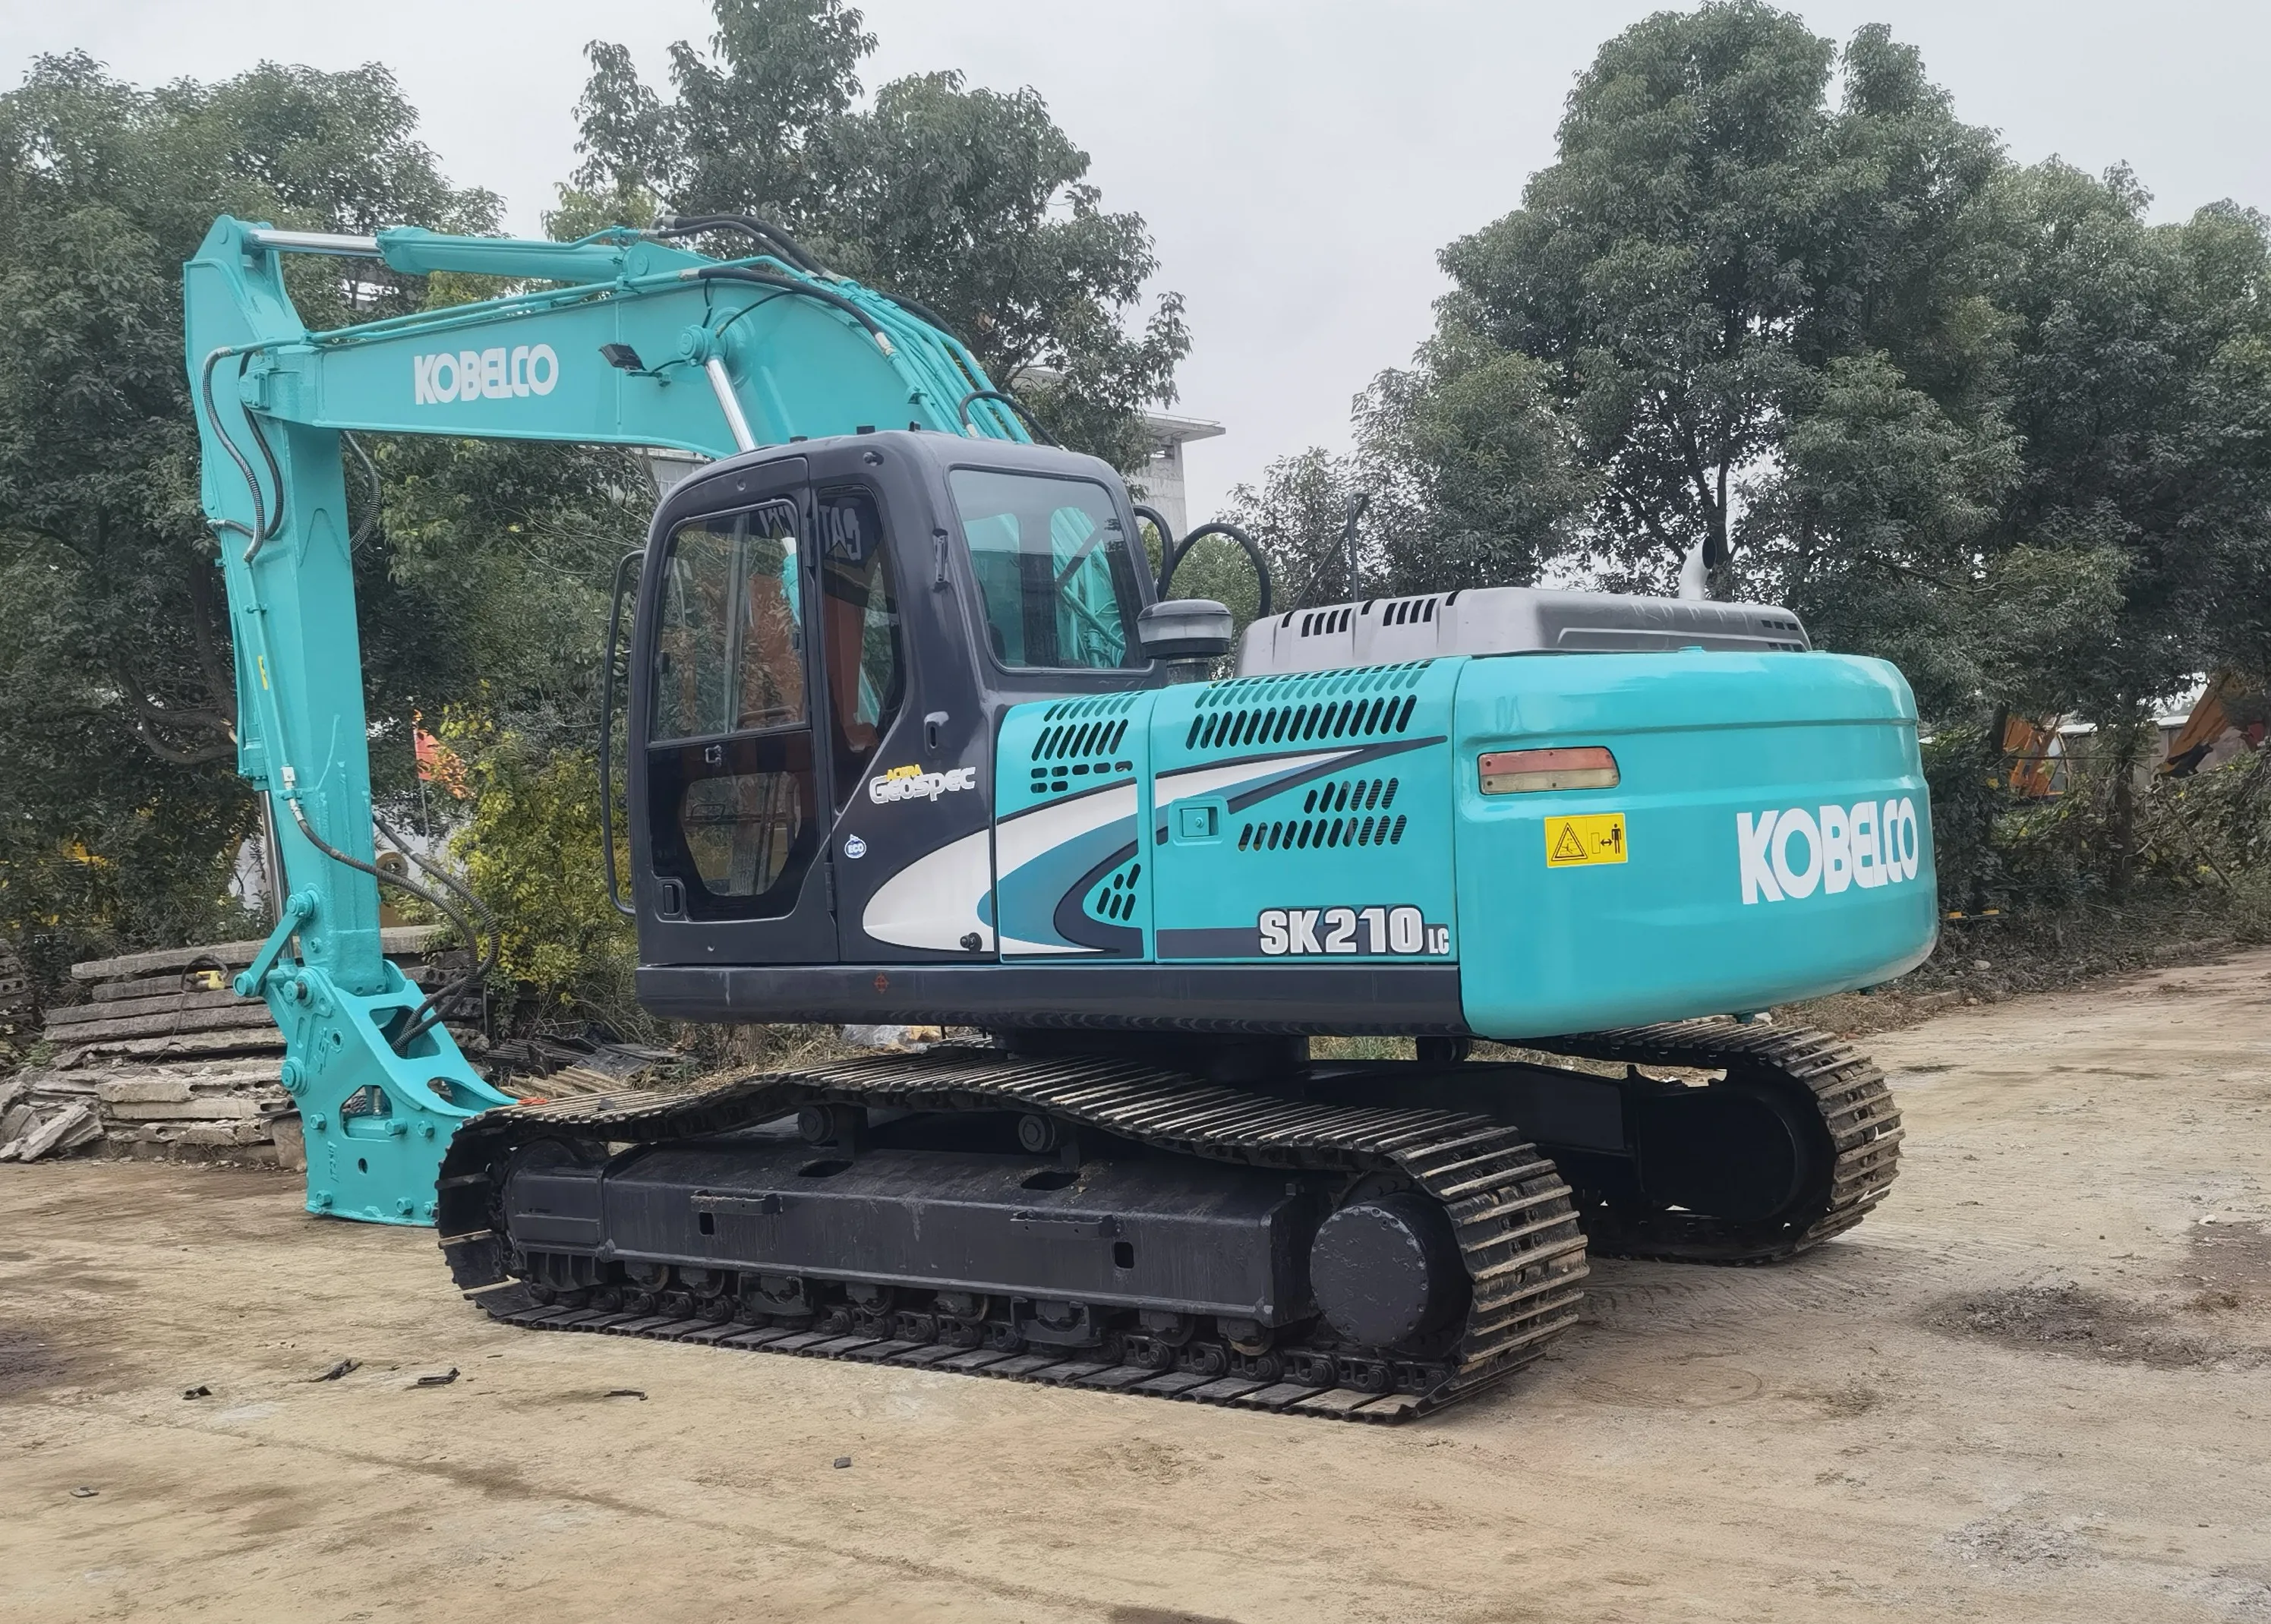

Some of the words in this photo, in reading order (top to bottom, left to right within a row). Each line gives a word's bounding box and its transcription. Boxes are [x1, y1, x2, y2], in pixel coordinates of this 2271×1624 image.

[414, 344, 559, 405] KOBELCO
[847, 843, 864, 854] ECO
[1736, 797, 1919, 905] KOBELCO
[1260, 907, 1423, 954] SK210
[1427, 927, 1449, 954] LC
